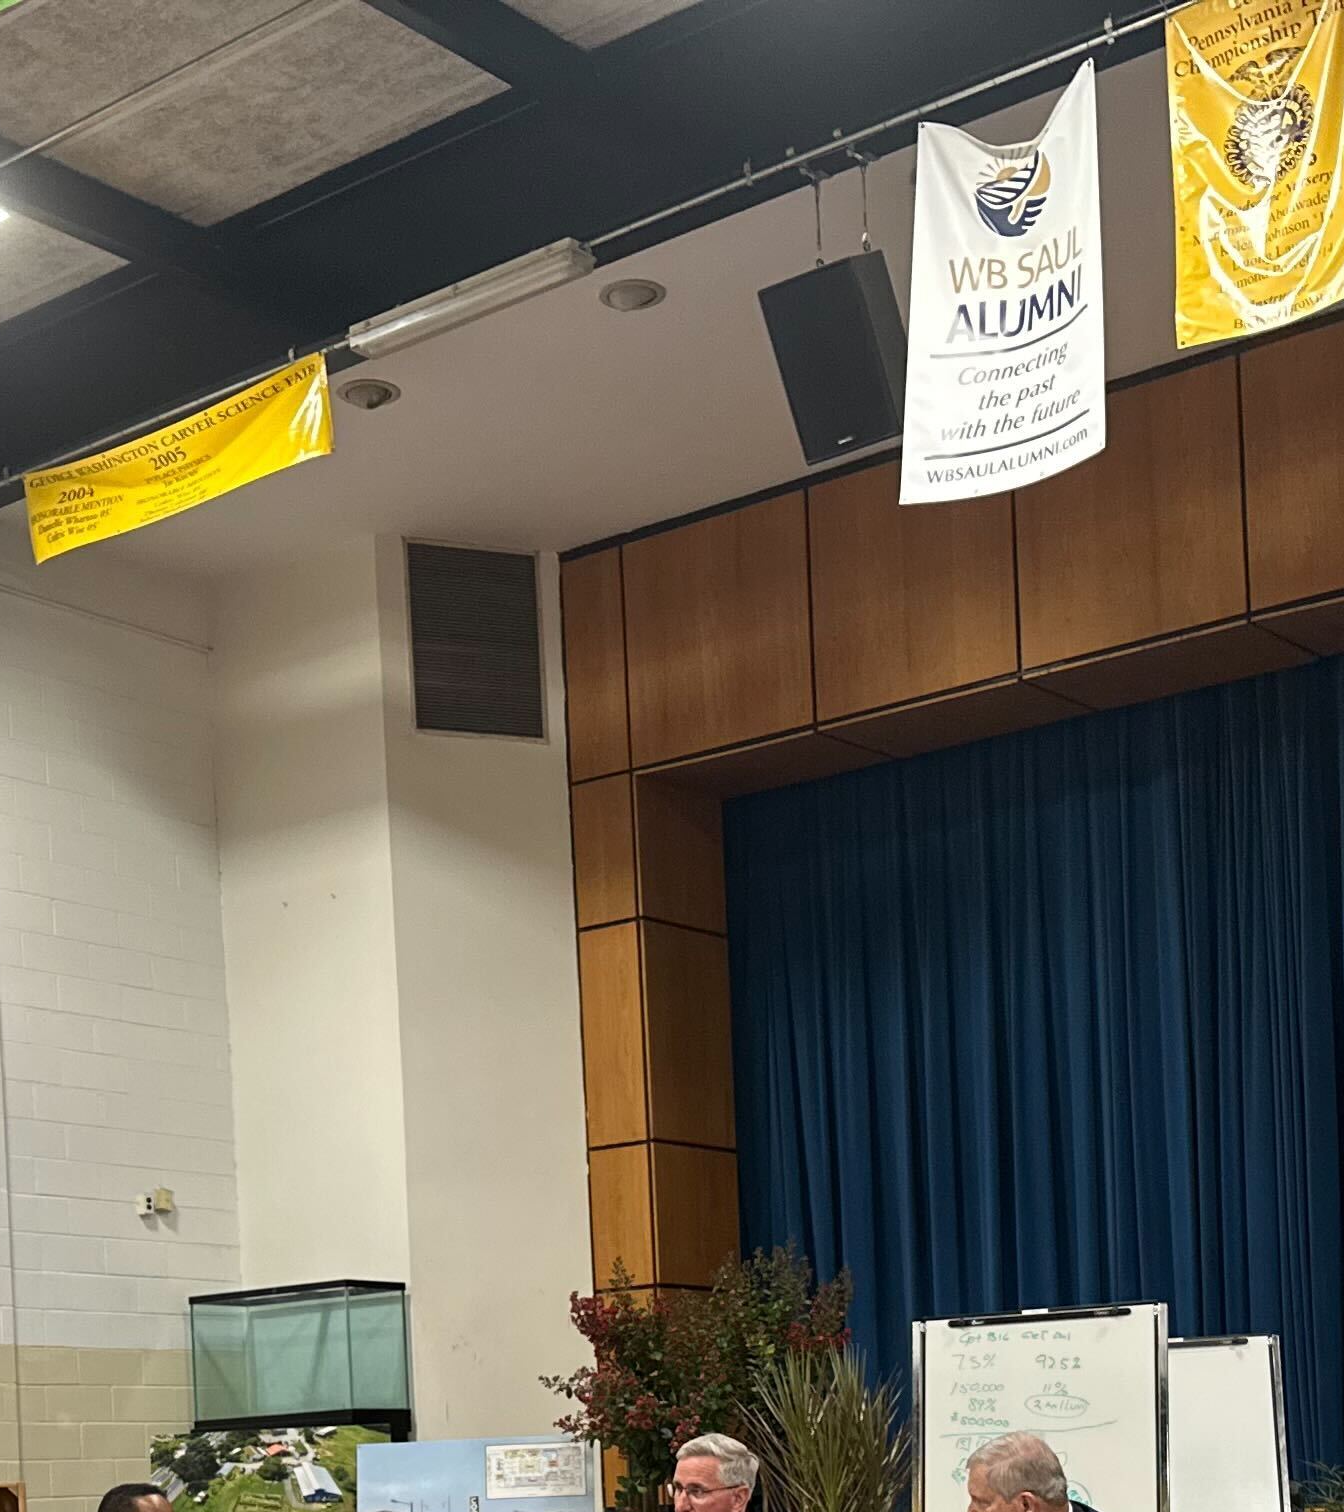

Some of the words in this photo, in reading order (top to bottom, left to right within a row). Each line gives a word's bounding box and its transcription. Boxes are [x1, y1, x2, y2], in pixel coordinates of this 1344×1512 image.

[1174, 21, 1303, 78] Chmpionship
[1187, 0, 1293, 53] Pennsylvania
[948, 257, 1008, 294] WB
[1018, 224, 1083, 290] SAUL
[945, 264, 1083, 345] ALUMNI
[957, 340, 1069, 387] Connecting
[940, 419, 986, 443] with
[993, 411, 1027, 436] the
[1031, 386, 1082, 426] future
[978, 389, 1013, 412] the
[1015, 374, 1056, 409] past
[29, 470, 74, 488] GEORGE
[74, 442, 160, 477] WASHINGTON
[160, 416, 217, 448] CARVER
[218, 383, 282, 423] SCIENCE
[284, 362, 317, 389] FAIR
[148, 446, 188, 472] 2005
[925, 424, 1089, 485] WBSAULALUMNI.com
[56, 484, 95, 504] 2004
